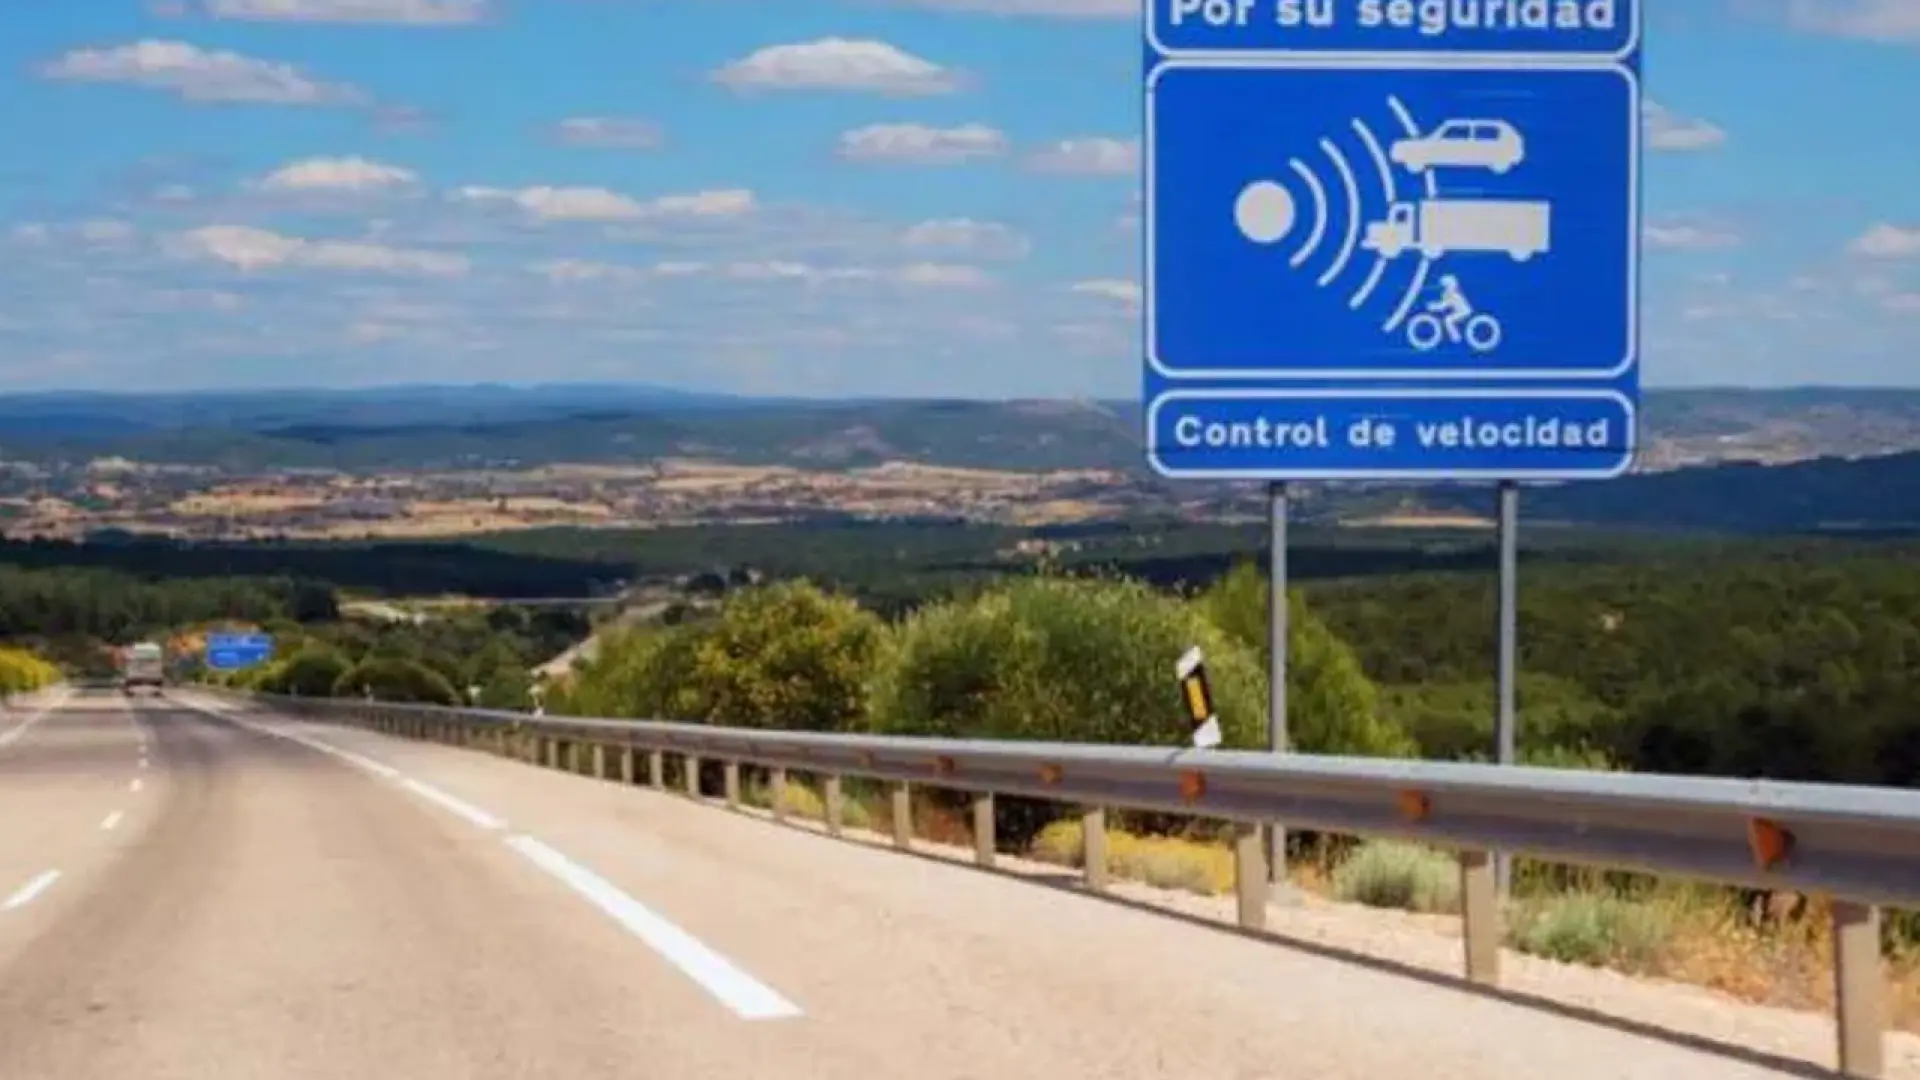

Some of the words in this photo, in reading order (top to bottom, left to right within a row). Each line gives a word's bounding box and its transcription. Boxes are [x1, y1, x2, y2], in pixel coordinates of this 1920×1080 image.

[1171, 0, 1255, 25] Por
[1279, 0, 1333, 26] su
[1358, 0, 1614, 34] seguridad
[1175, 416, 1327, 446] Control
[1349, 419, 1395, 446] de
[1418, 418, 1608, 446] velocidad
